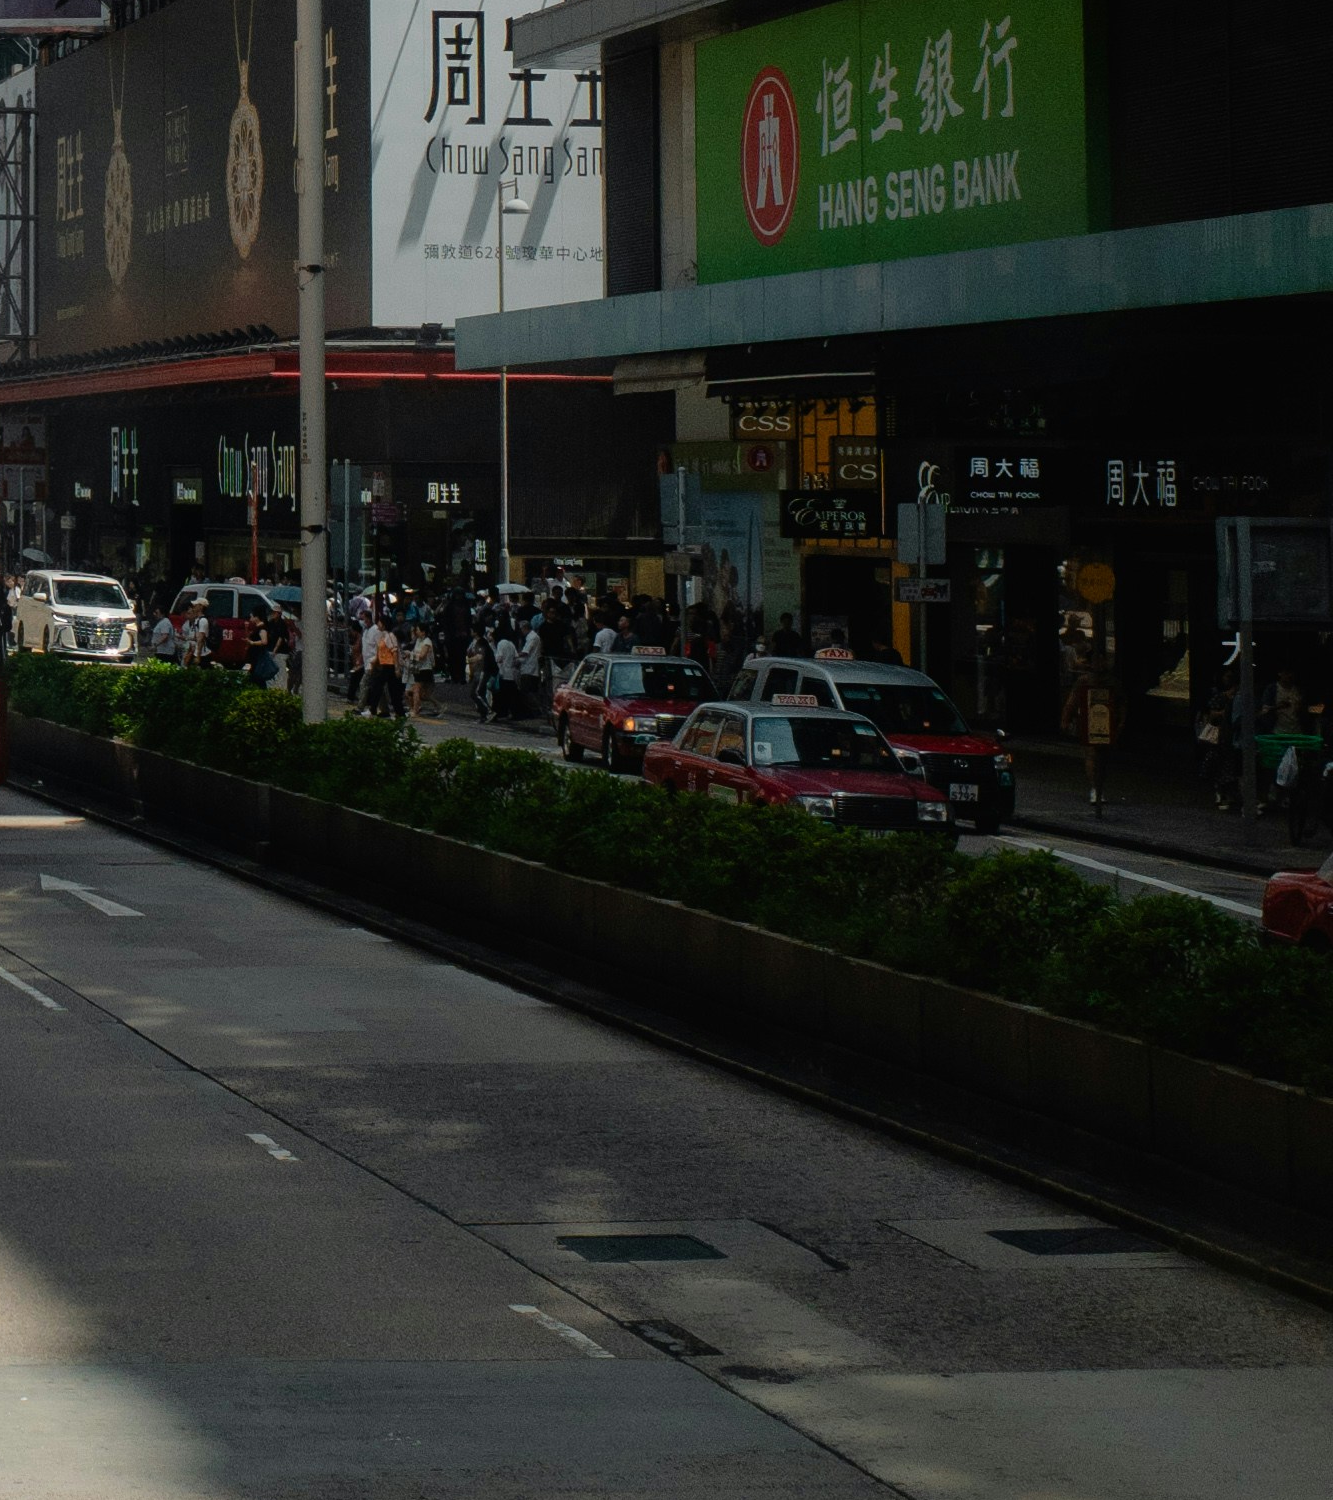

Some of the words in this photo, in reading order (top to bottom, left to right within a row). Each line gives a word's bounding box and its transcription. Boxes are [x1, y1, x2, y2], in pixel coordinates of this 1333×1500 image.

[426, 137, 489, 175] Chow
[498, 136, 554, 184] Sang
[819, 179, 877, 231] HANG
[886, 168, 944, 219] SENG
[953, 149, 1021, 209] BANK
[739, 416, 791, 431] CSS
[970, 457, 1040, 480] 周大福
[427, 482, 461, 504] 周生生
[1106, 459, 1177, 507] 周大福
[970, 491, 995, 500] CHOW
[1016, 491, 1041, 500] FOOK
[788, 498, 866, 526] EMPEROR
[823, 649, 849, 657] TAXI
[778, 696, 815, 705] TAXI
